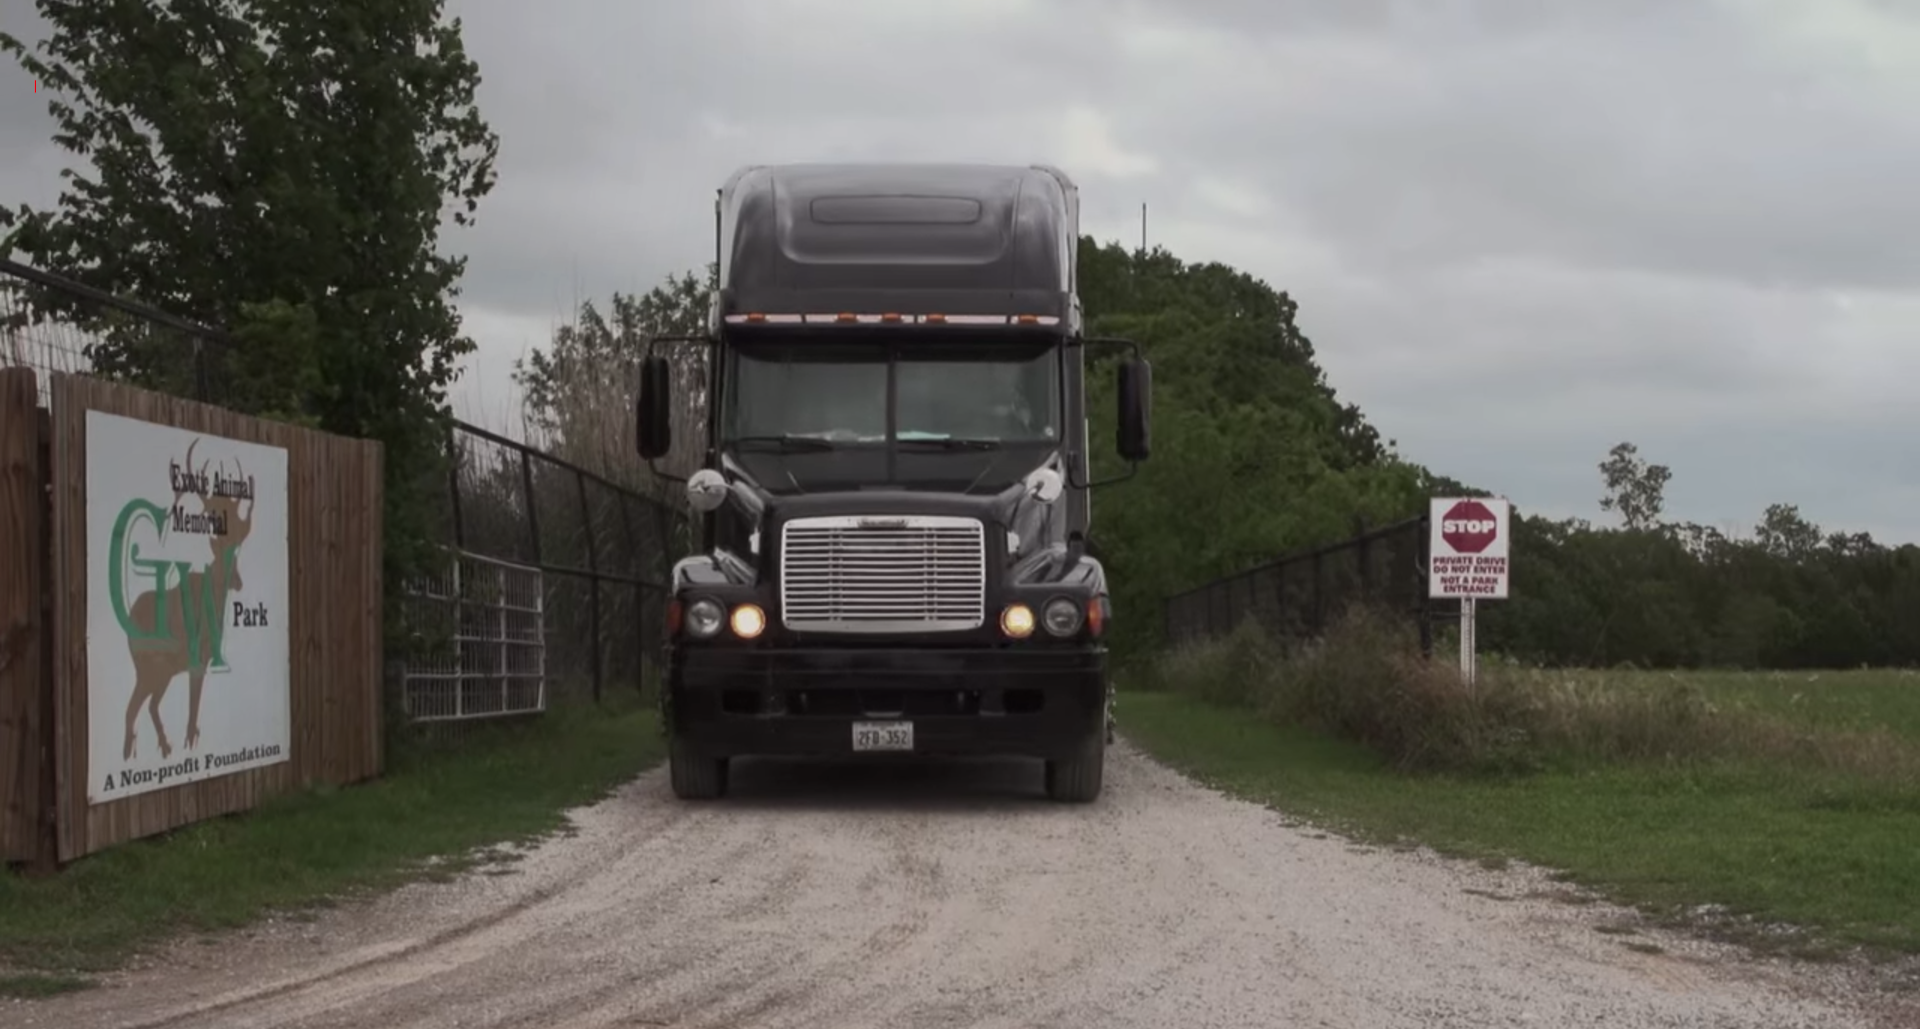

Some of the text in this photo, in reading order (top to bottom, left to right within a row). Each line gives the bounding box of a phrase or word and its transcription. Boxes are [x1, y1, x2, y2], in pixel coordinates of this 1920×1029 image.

[171, 463, 254, 500] Exotic Animal
[172, 505, 228, 536] Memorial
[1443, 520, 1496, 534] STOP
[1433, 557, 1506, 565] PRIVATE DRIVE
[1433, 566, 1505, 574] DO NOT ENTER
[108, 498, 242, 671] GW
[1441, 576, 1499, 585] NOT A PARK
[1443, 585, 1495, 594] ENTRANCE
[233, 602, 268, 627] Park
[103, 743, 281, 792] A Non-profit Foundation
